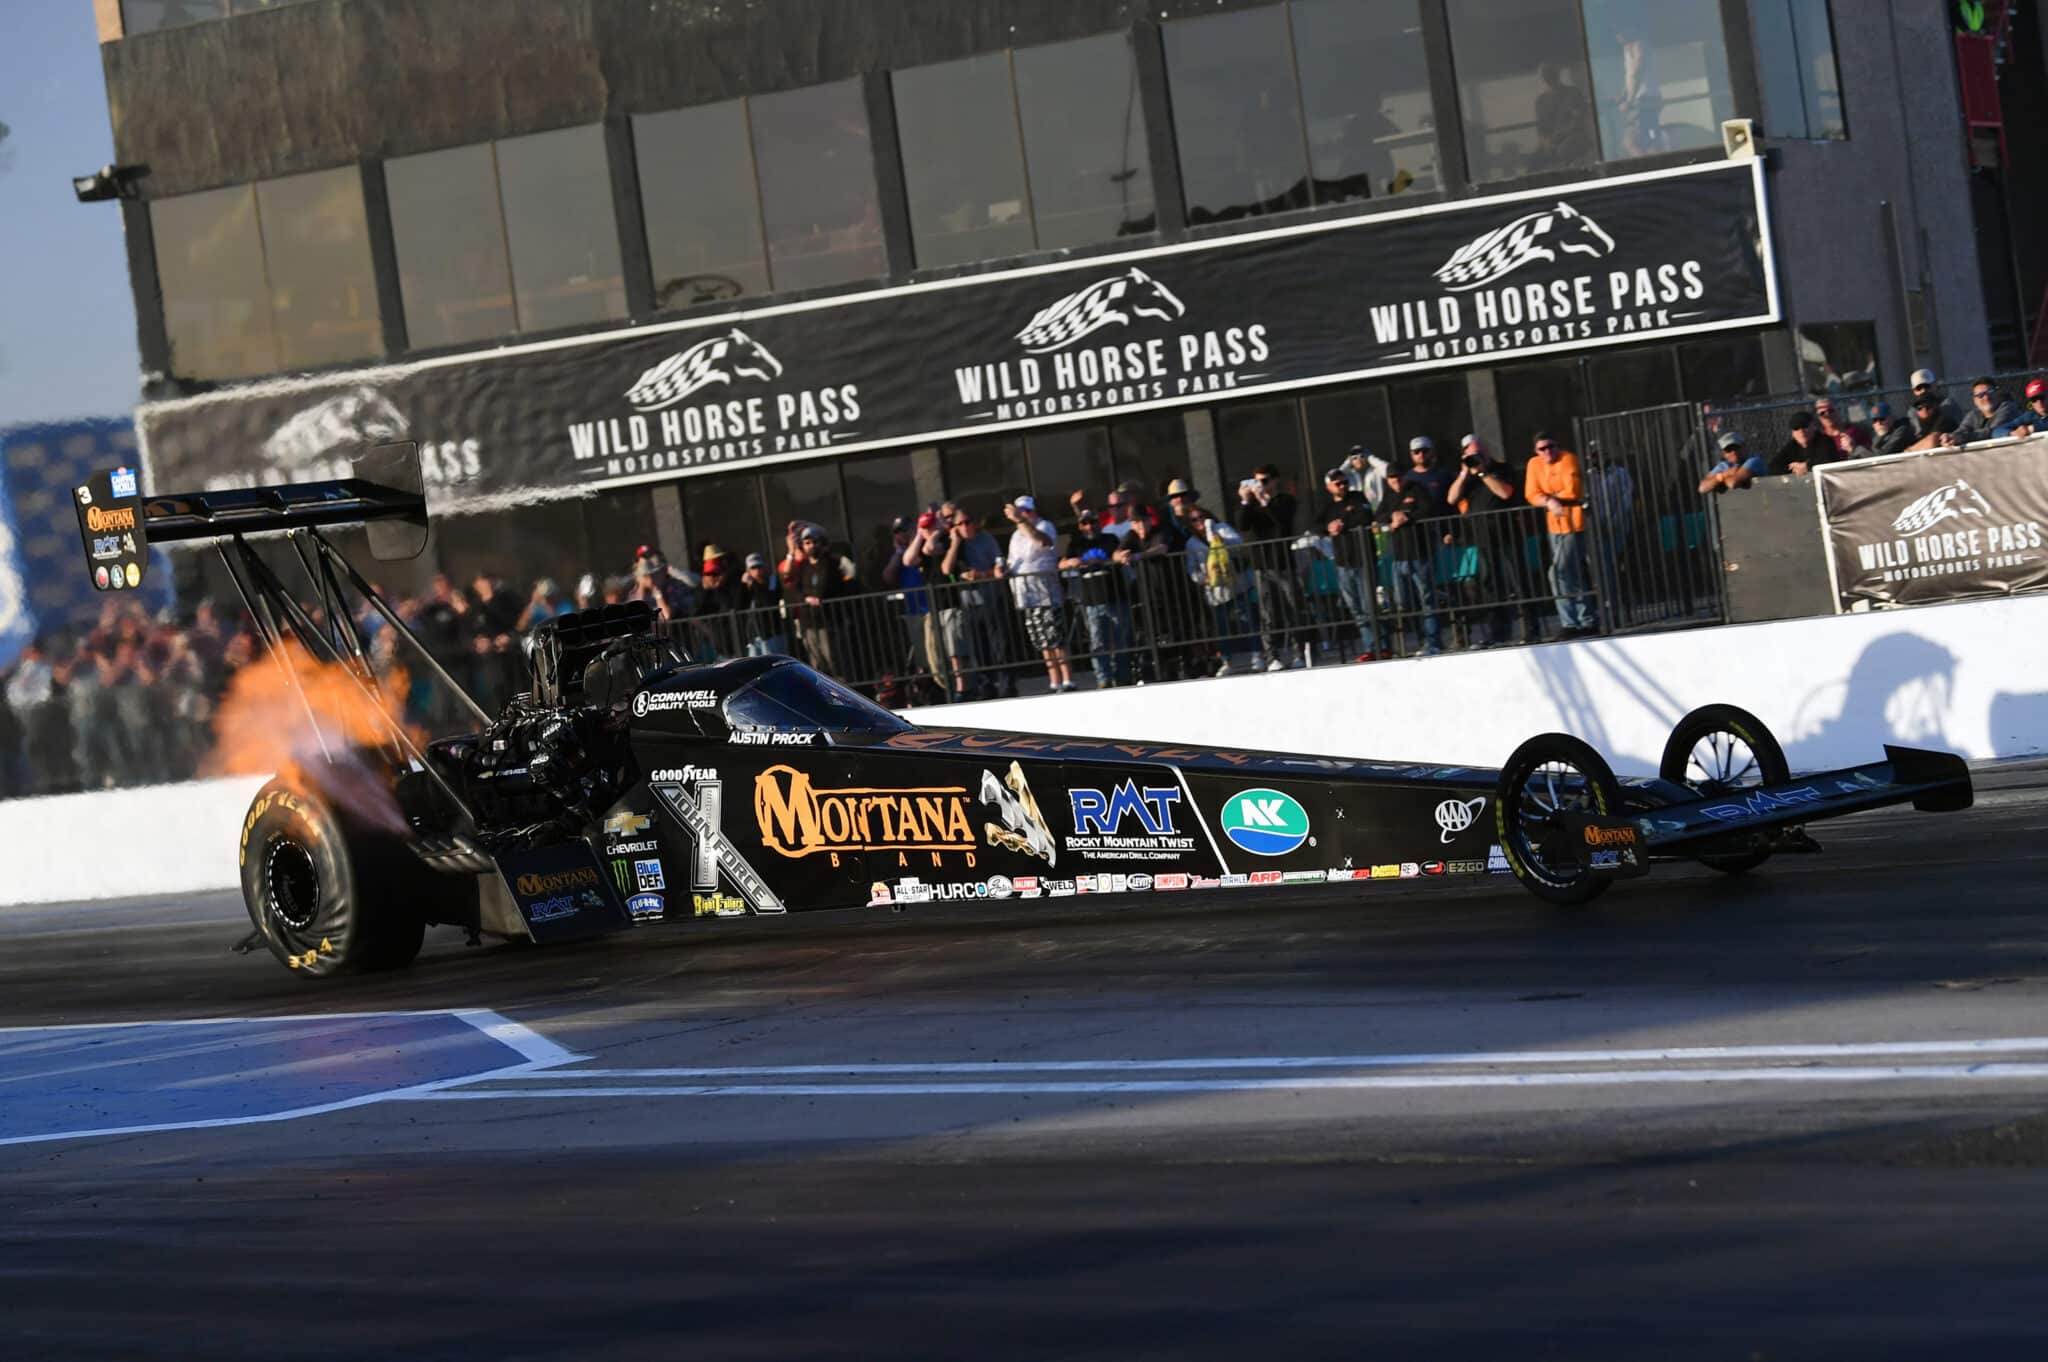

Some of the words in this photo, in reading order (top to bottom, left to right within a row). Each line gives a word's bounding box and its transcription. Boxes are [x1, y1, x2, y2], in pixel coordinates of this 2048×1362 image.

[1370, 296, 1461, 344] WILD
[1474, 276, 1596, 329] HORSE
[1609, 260, 1704, 310] PASS
[1414, 320, 1591, 361] MOTORSPORTS
[1606, 309, 1670, 333] PARK
[955, 358, 1041, 404] WILD
[1054, 339, 1167, 390] HORSE
[1179, 324, 1269, 372] PASS
[997, 382, 1163, 420] MOTORSPORTS
[1177, 371, 1237, 394] PARK
[568, 415, 649, 459] WILD
[660, 398, 766, 446] HORSE
[777, 384, 861, 430] PASS
[420, 438, 481, 480] ASS
[608, 440, 763, 475] MOTORSPORTS
[775, 429, 831, 451] PARK
[78, 485, 92, 504] 3
[88, 506, 135, 531] MONTANA
[1858, 540, 1910, 570] WILD
[1914, 530, 1981, 563] HORSE
[1987, 522, 2041, 552] PASS
[1883, 559, 1981, 582] MOTORSPORTS
[1987, 554, 2024, 568] PARK
[649, 702, 684, 710] QUALITY
[687, 700, 716, 708] TOOLS
[650, 690, 718, 702] CORNWELL
[728, 731, 769, 744] AUSTIN
[771, 733, 816, 744] PROCK
[651, 765, 717, 784] GOODYEAR
[755, 765, 976, 857] MONTANA
[1068, 777, 1180, 835] RMT
[1240, 799, 1288, 827] NK
[1439, 802, 1469, 829] AAA
[606, 840, 658, 855] CHEVROLET
[668, 791, 715, 840] JOHN
[712, 839, 766, 902] FORCE
[1066, 836, 1101, 848] ROCKY
[1103, 836, 1157, 848] MOUNTAIN
[1161, 837, 1194, 848] TWIST
[1584, 825, 1636, 845] MONTANA
[637, 862, 659, 875] Blue
[1082, 851, 1096, 859] THE
[1096, 851, 1128, 859] AMERICAN
[1129, 851, 1148, 859] DRILL
[1148, 852, 1180, 860] COMPANY
[518, 867, 598, 896] MONTANA
[640, 873, 663, 889] DEF
[929, 882, 988, 900] HURCO
[1050, 880, 1074, 890] WELD
[1251, 872, 1281, 884] ARP
